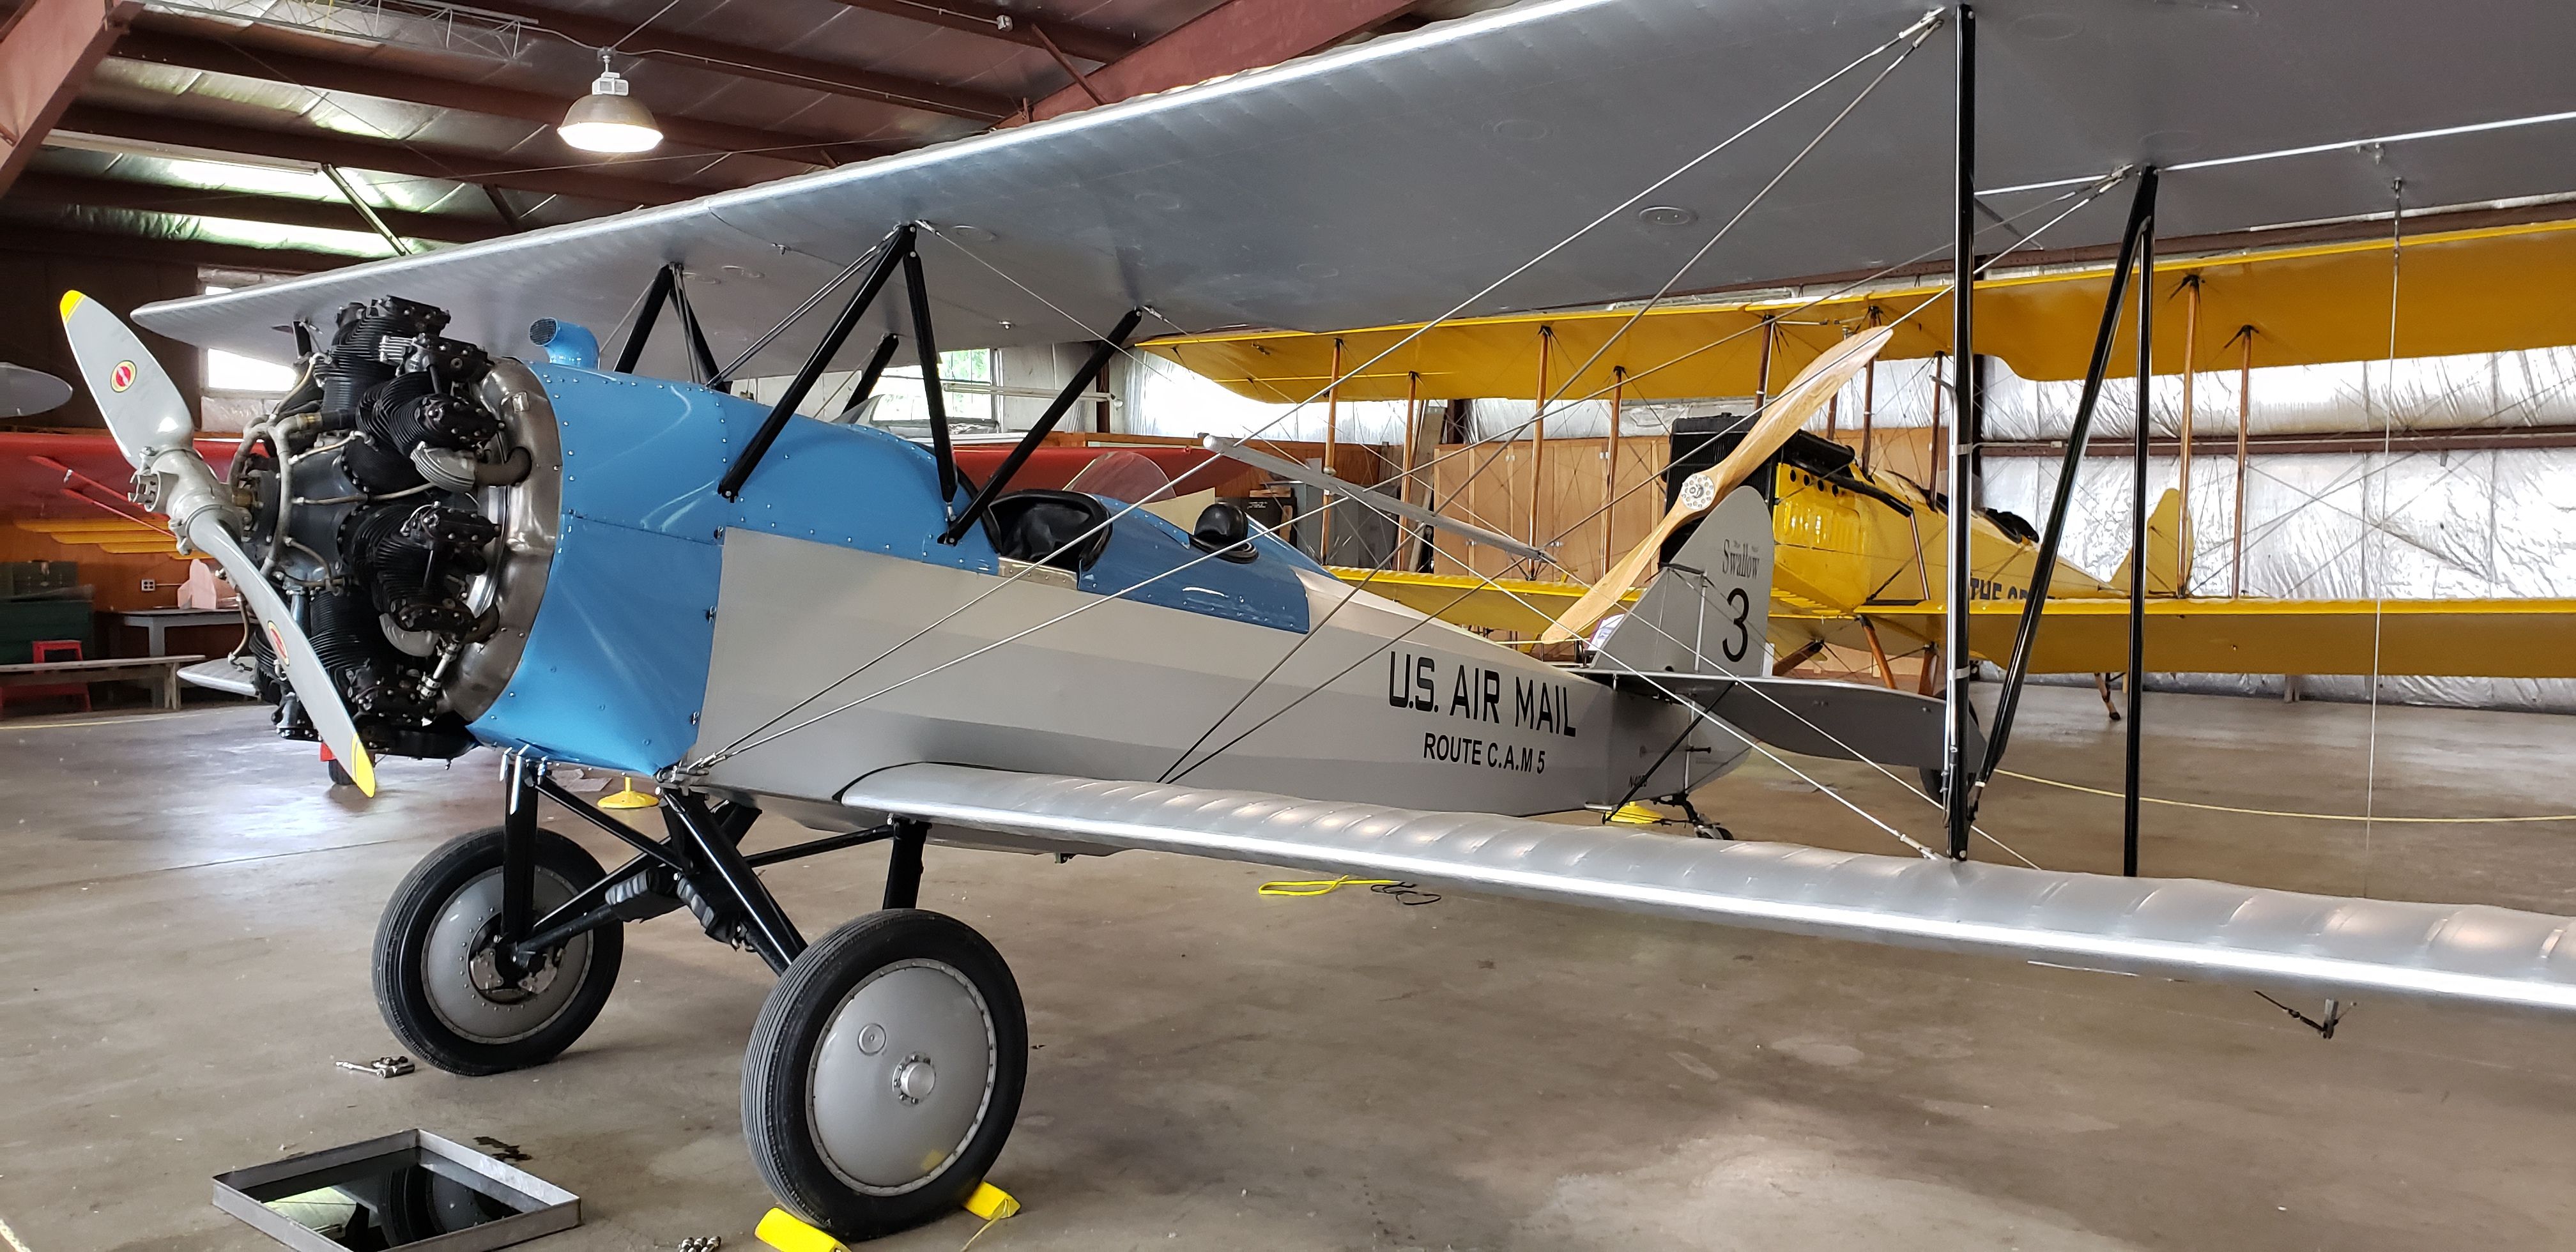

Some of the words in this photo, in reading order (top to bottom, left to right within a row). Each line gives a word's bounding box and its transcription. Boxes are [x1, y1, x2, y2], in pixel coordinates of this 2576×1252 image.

[1722, 538, 1759, 579] Swallow
[1722, 588, 1749, 662] 3
[1390, 651, 1439, 713] U.S.
[1449, 664, 1500, 724] AIR
[1515, 676, 1576, 737] MAIL
[1423, 732, 1483, 765] ROUTE
[1487, 742, 1533, 772] C.A.M
[1537, 751, 1545, 774] 5
